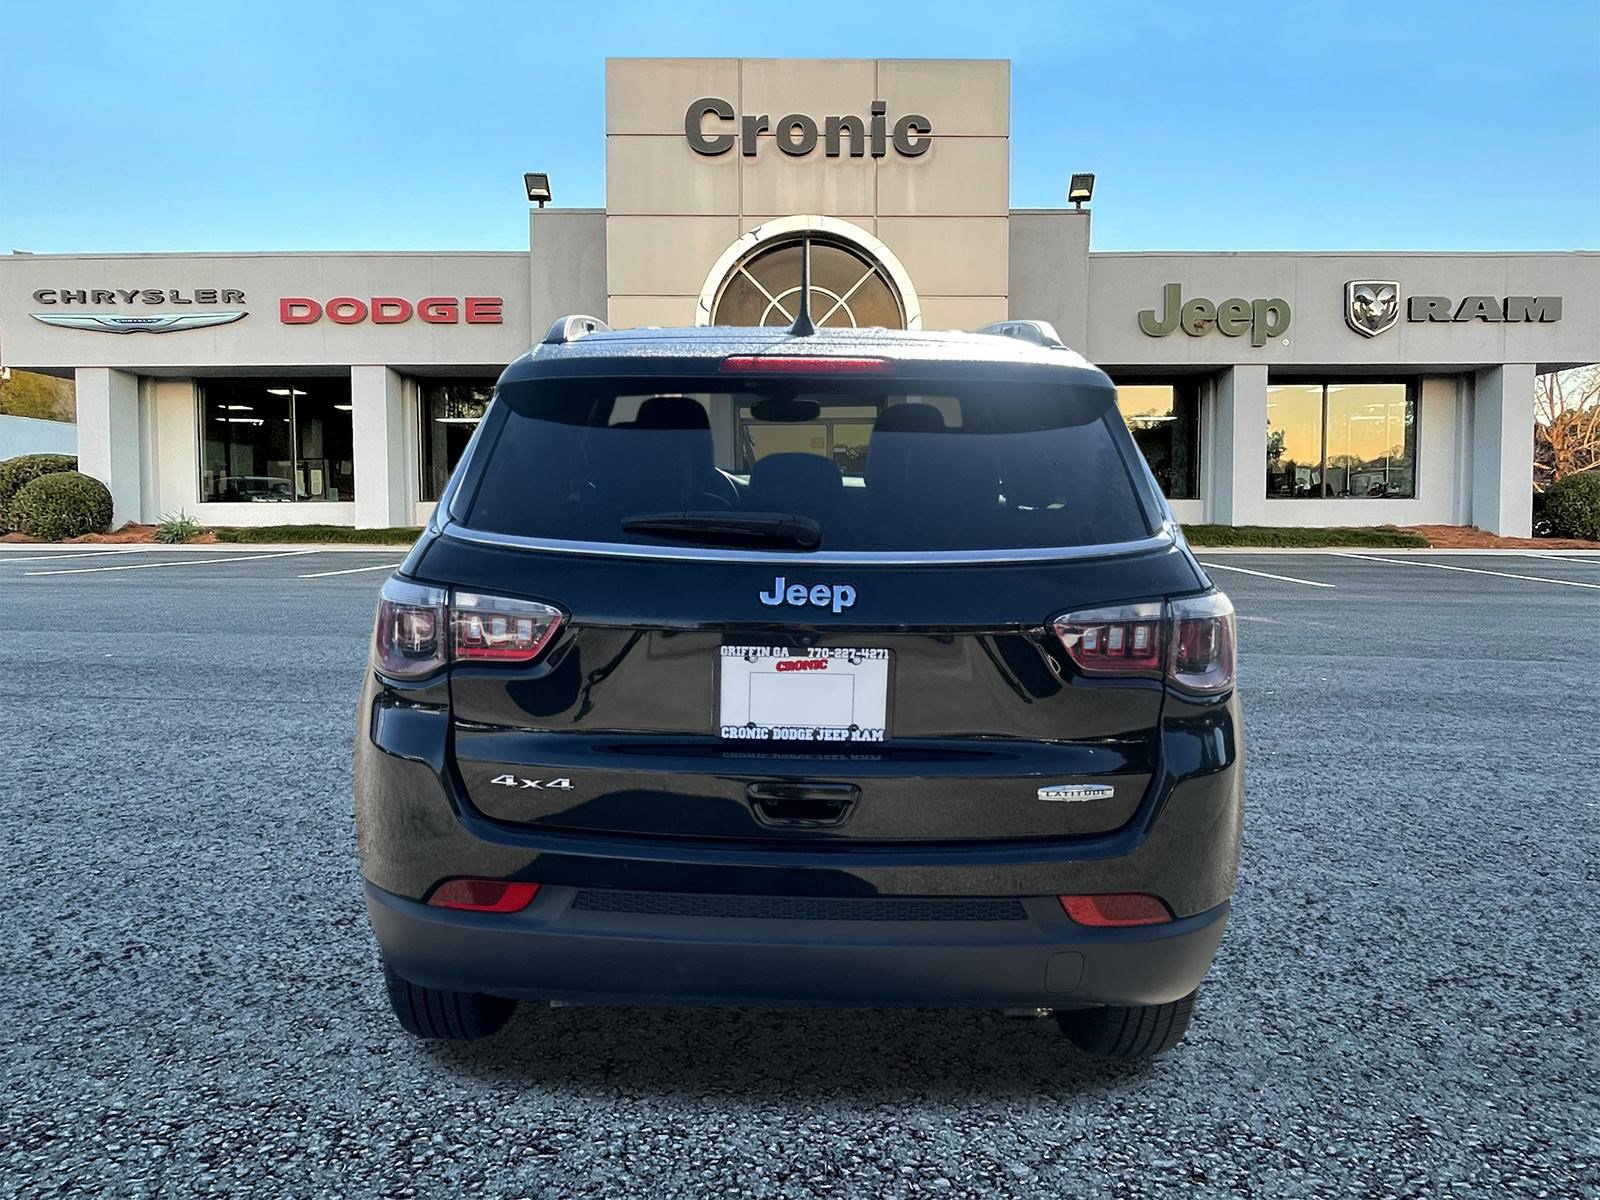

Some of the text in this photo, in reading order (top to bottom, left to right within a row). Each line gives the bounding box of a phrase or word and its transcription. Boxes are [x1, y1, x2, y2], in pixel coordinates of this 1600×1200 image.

[685, 97, 932, 157] Cronic
[32, 289, 246, 304] CHRYSLER
[279, 297, 503, 325] DODGE
[1138, 283, 1291, 347] Jeep
[1407, 296, 1562, 323] RAM
[759, 577, 857, 613] Jeep
[720, 646, 790, 658] GRIFFIN GA
[807, 648, 889, 659] 770-227-4271
[776, 659, 828, 672] CRONIC
[721, 726, 884, 742] CRONIC DODGE JEEP RAM
[491, 774, 574, 791] 4x4
